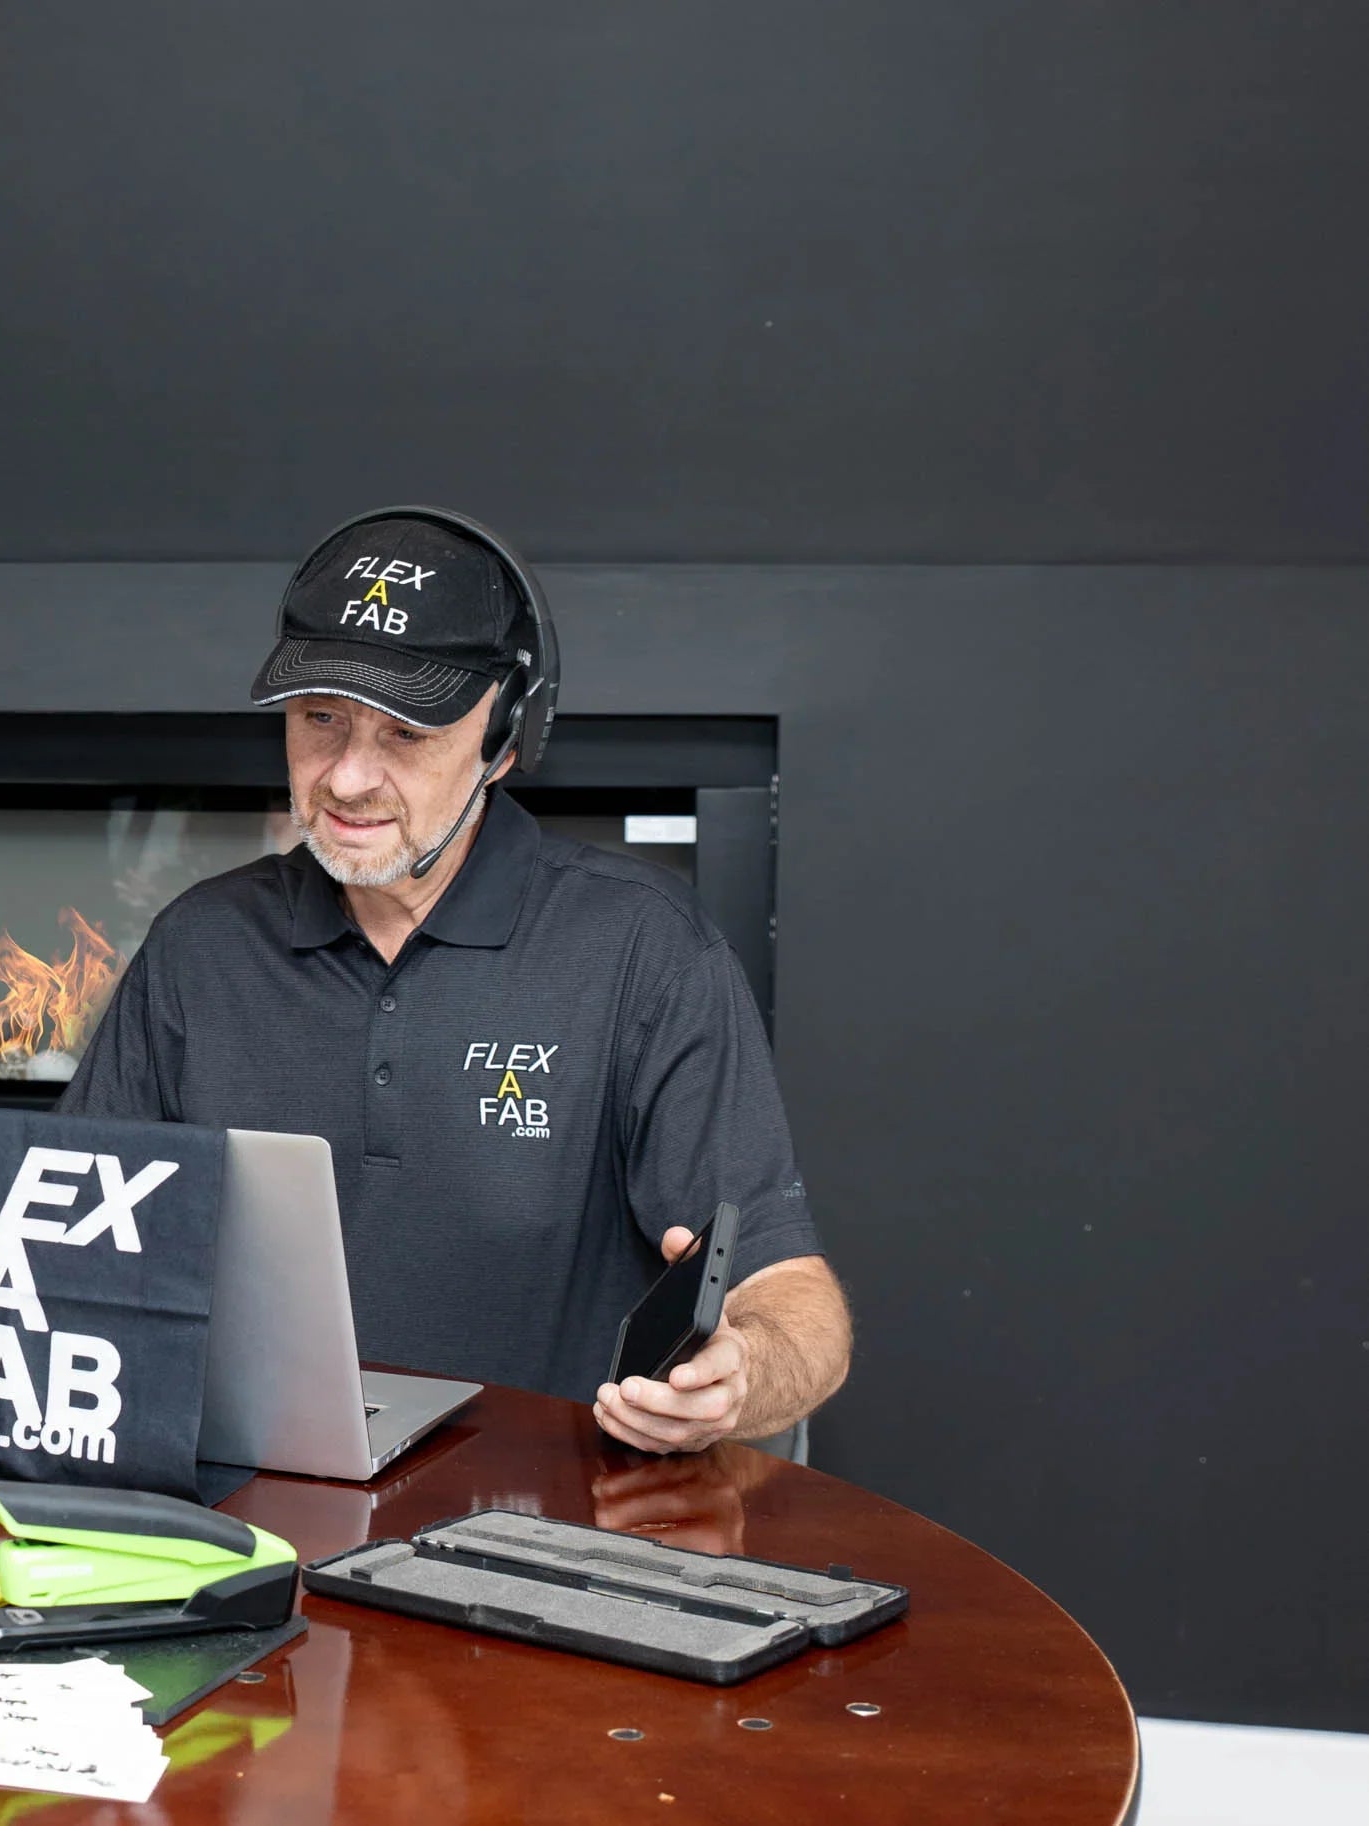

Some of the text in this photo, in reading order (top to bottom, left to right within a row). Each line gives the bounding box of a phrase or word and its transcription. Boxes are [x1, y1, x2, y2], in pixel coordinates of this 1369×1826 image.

[343, 556, 437, 592] FLEX
[363, 579, 389, 606] A
[339, 600, 409, 636] FAB
[462, 1042, 559, 1074] FLEX
[497, 1070, 523, 1099] A
[479, 1096, 550, 1127] FAB
[511, 1126, 550, 1139] .com
